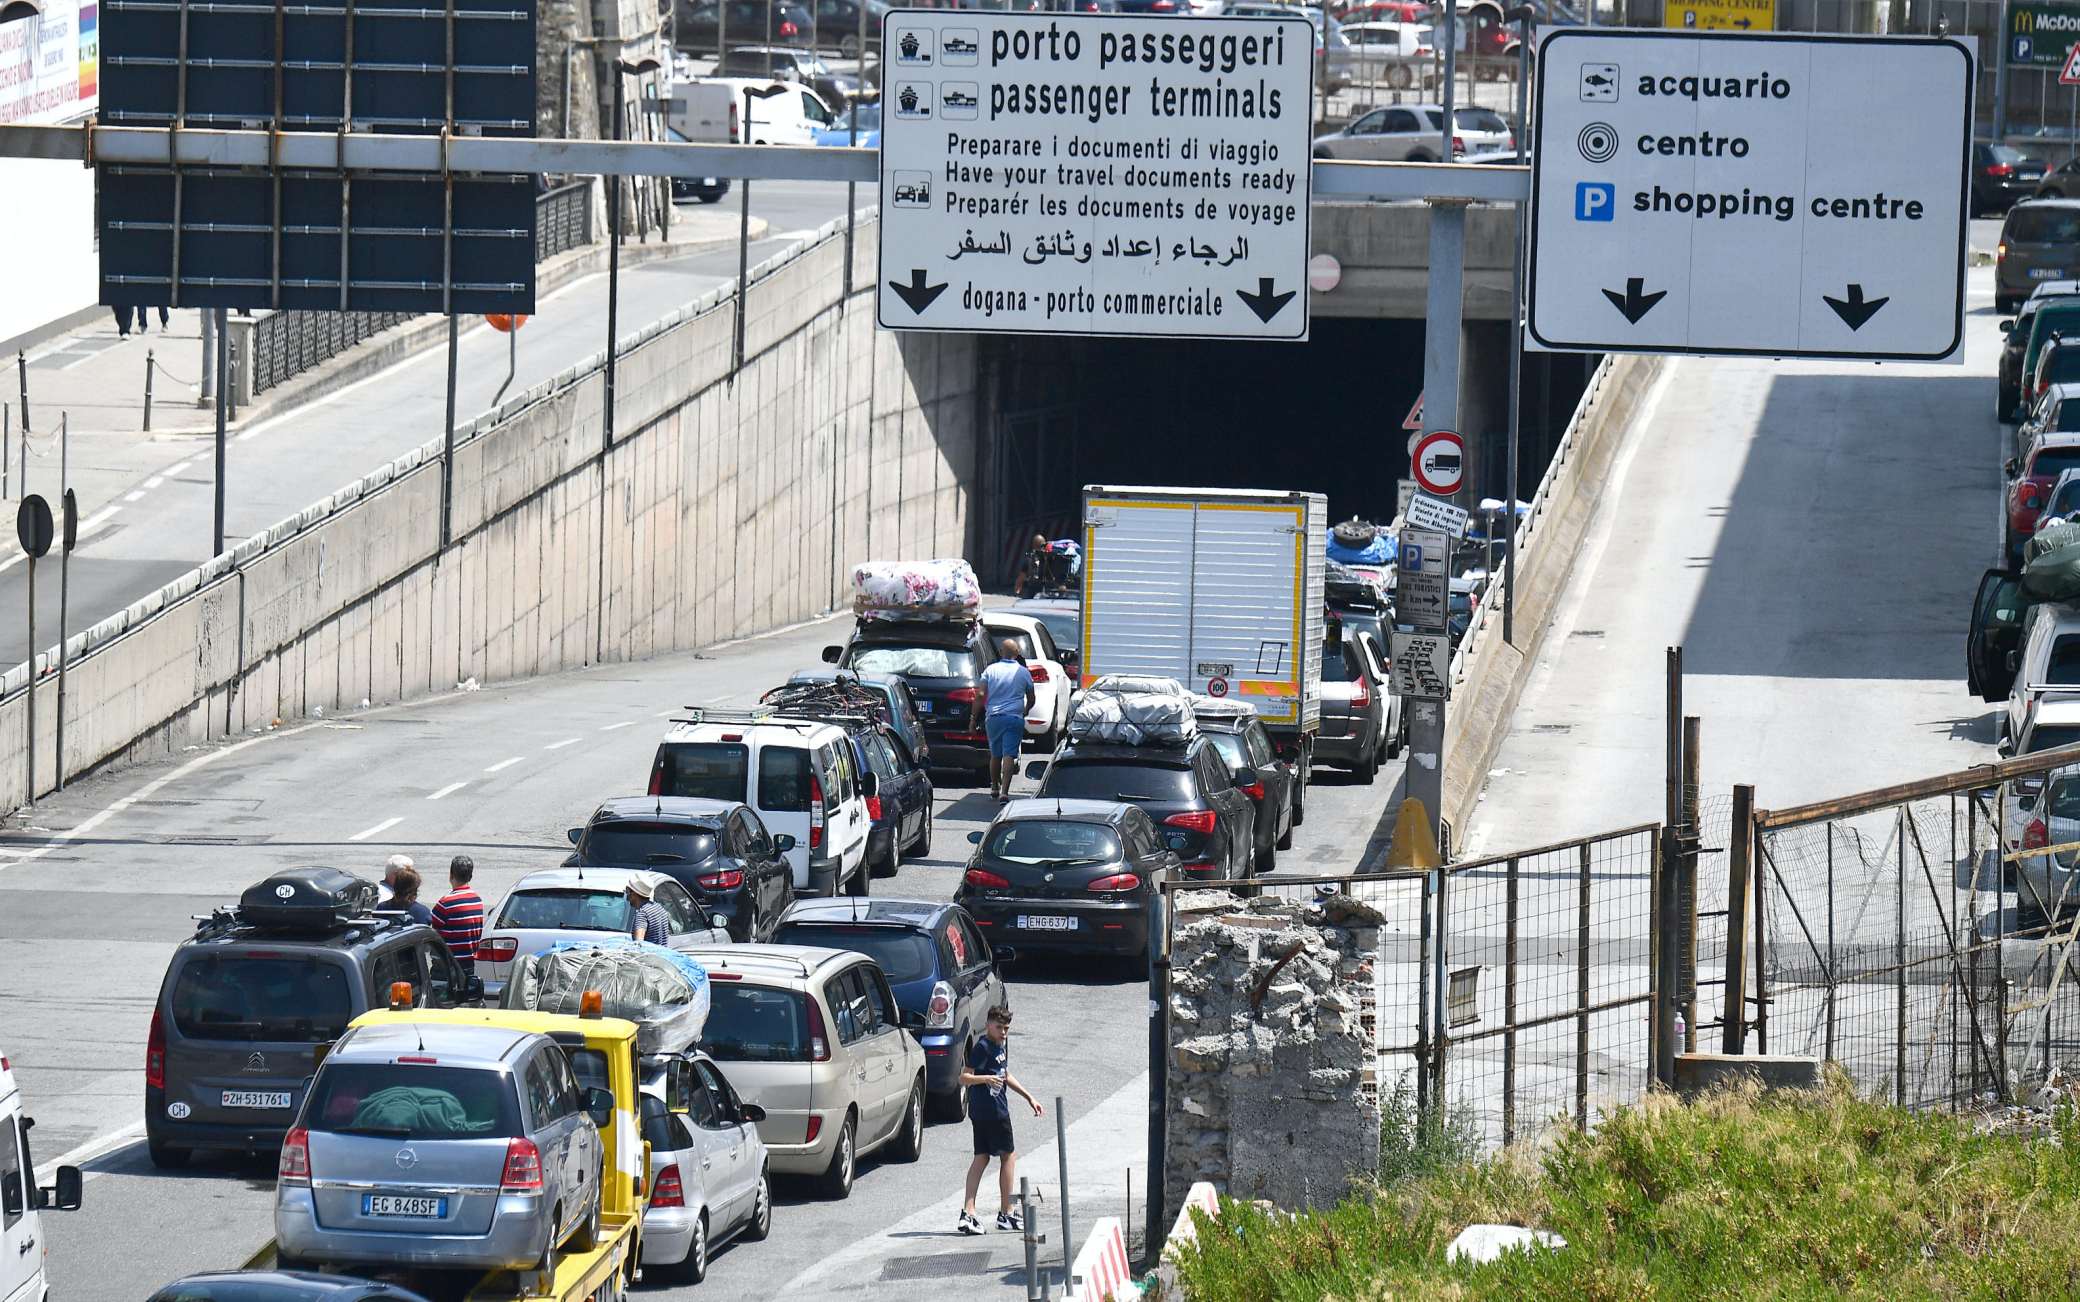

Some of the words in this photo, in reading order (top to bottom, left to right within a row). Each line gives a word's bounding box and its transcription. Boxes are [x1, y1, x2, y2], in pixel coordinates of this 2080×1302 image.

[991, 21, 1081, 68] porto
[1101, 26, 1284, 74] passeggeri
[990, 83, 1131, 124] passenger
[1150, 77, 1282, 119] terminals
[1637, 71, 1791, 102] acquario
[948, 132, 1042, 160] Preparare
[1068, 135, 1170, 160] documenti
[1180, 137, 1198, 160] di
[1209, 139, 1279, 166] viaggio
[1637, 131, 1750, 158] centro
[946, 160, 993, 184] Have
[1004, 167, 1047, 189] your
[1057, 163, 1114, 187] travel
[1124, 164, 1231, 189] documents
[1242, 167, 1296, 195] ready
[946, 191, 1029, 219] Preparér
[1040, 193, 1067, 216] les
[1077, 194, 1184, 219] documents
[1194, 197, 1217, 220] de
[1228, 203, 1296, 226] voyage
[1632, 186, 1795, 222] shopping
[1811, 193, 1924, 221] centre
[945, 229, 1012, 261] السفر
[1022, 229, 1093, 265] وثائق
[1102, 234, 1161, 267] إعداد
[1172, 235, 1249, 267] الرجاء
[962, 281, 1027, 318] dogana
[1046, 285, 1095, 320] porto
[1103, 287, 1223, 317] commerciale
[279, 886, 291, 897] CH
[172, 1104, 186, 1117] CH
[371, 1197, 390, 1212] EG
[394, 1198, 437, 1214] 848SF
